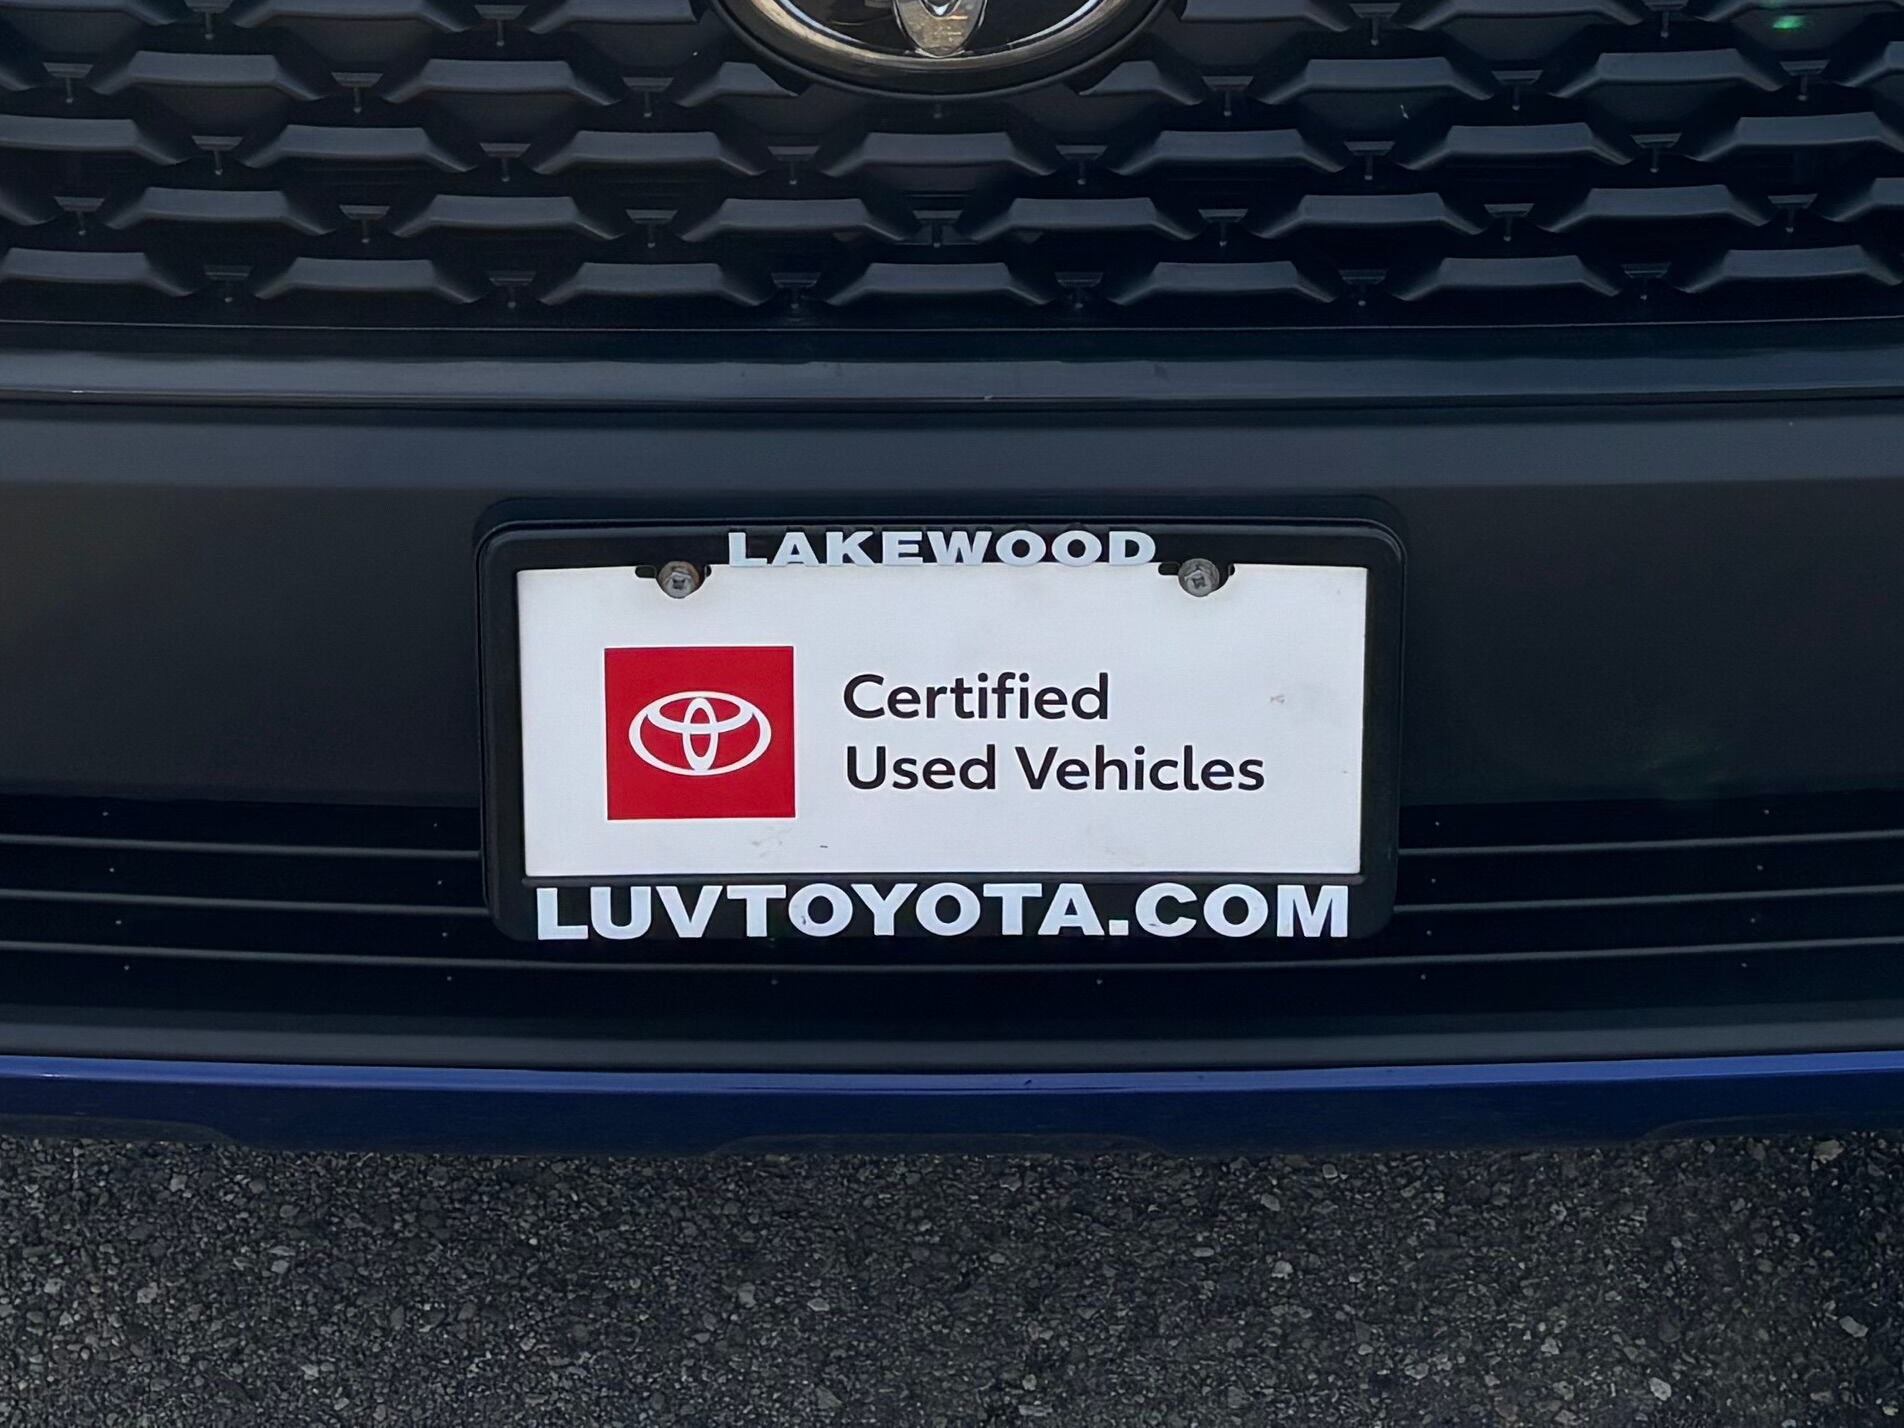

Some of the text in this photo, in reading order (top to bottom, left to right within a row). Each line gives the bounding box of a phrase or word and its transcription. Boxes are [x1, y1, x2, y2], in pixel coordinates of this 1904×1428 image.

[727, 529, 1157, 567] LAKEWOOD
[843, 672, 1111, 722] Certified
[846, 744, 1266, 794] Used Vehicles
[535, 881, 1350, 941] LUVTOYOTA.COM
